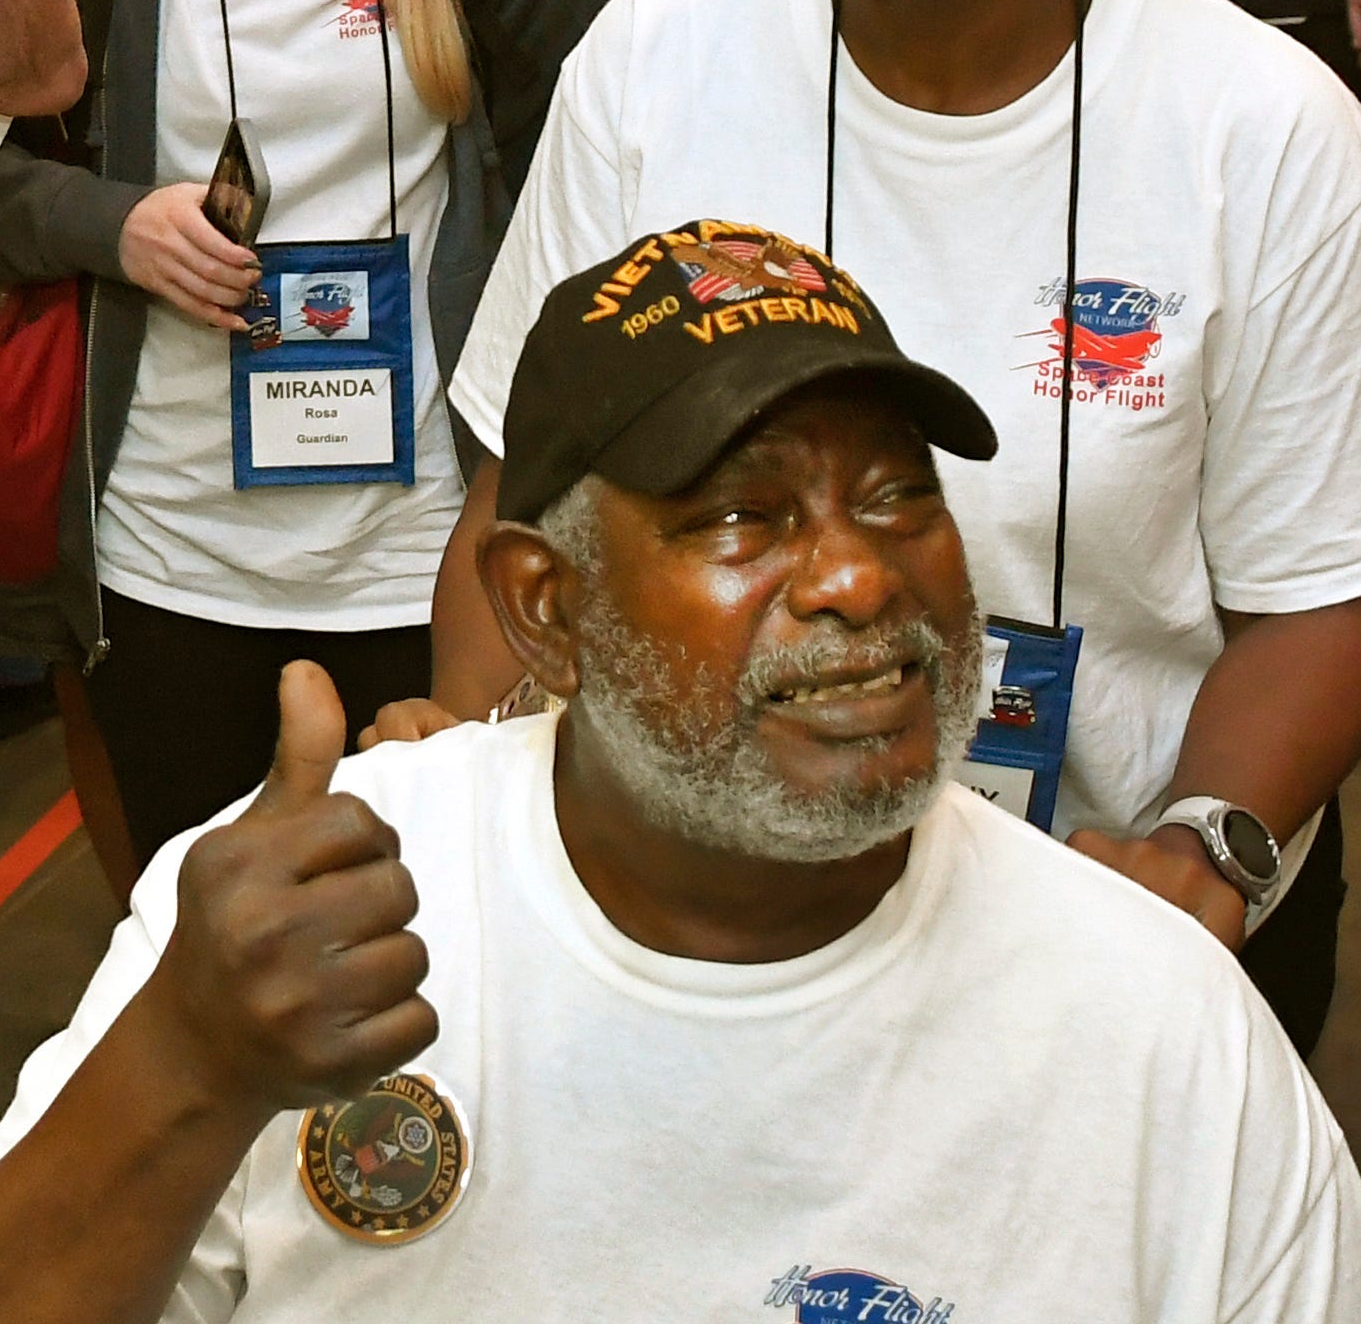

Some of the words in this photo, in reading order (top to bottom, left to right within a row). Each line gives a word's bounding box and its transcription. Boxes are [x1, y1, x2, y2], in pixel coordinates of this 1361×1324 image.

[621, 295, 681, 340] 1960
[683, 296, 861, 345] VETERAN
[1107, 286, 1187, 326] Flight
[265, 378, 377, 400] MIRANDA
[1105, 389, 1166, 412] Flight
[304, 407, 338, 420] Rosa
[296, 434, 348, 444] Guardian
[383, 1078, 443, 1119] UNITED
[431, 1131, 457, 1204] STATES
[309, 1150, 345, 1209] ARMY
[764, 1264, 850, 1311] Honor
[857, 1284, 956, 1324] Flight
